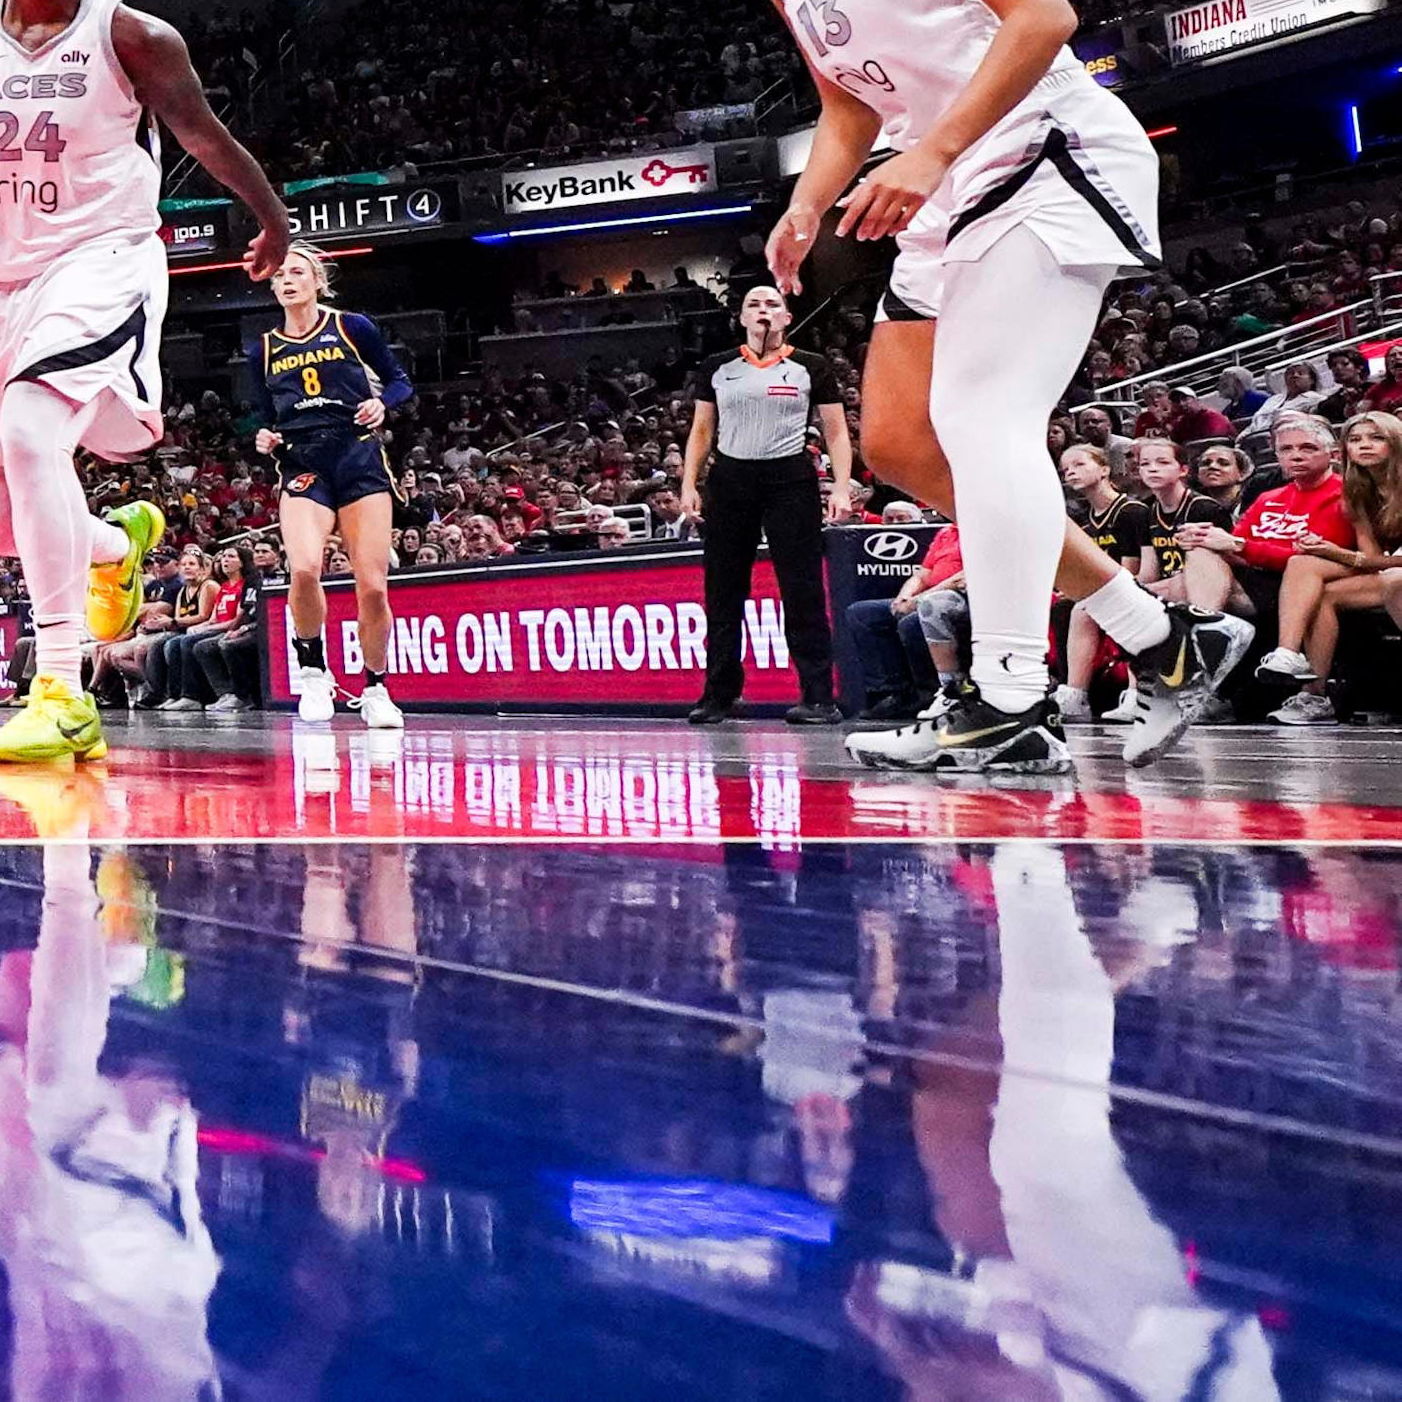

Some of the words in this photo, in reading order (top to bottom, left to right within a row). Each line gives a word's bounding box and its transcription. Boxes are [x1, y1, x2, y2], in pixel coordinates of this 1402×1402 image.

[1172, 34, 1226, 63] Members
[1230, 22, 1267, 49] Credit
[1270, 10, 1308, 36] Union
[61, 51, 91, 67] ally
[505, 171, 636, 206] KeyBank
[289, 196, 398, 234] SHIFT
[271, 346, 346, 375] INDIANA
[301, 366, 322, 396] 8
[341, 614, 449, 675] BNG
[456, 610, 514, 674] ON
[518, 598, 791, 672] TOMORRW
